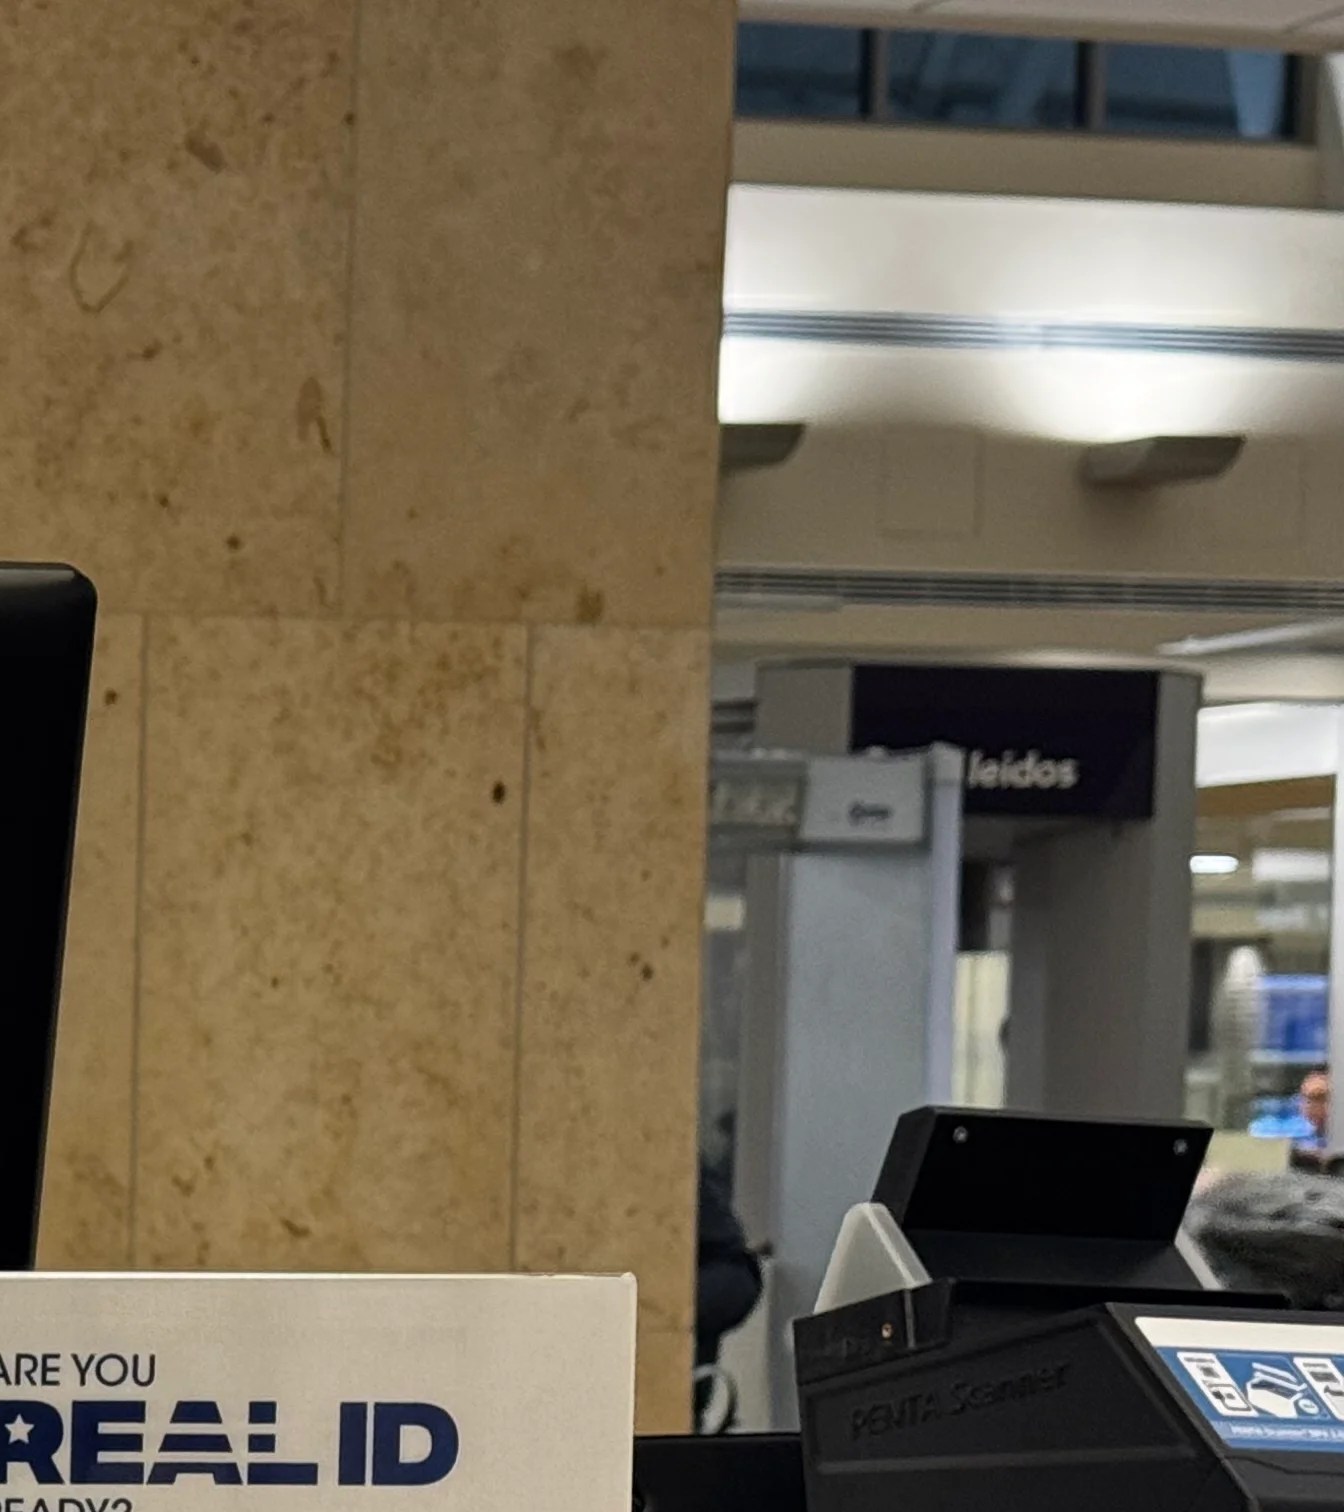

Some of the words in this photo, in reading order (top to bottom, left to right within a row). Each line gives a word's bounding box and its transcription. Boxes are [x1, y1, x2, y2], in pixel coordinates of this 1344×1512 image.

[968, 749, 1080, 791] leidos
[71, 1354, 155, 1387] YOU
[850, 1393, 939, 1440] PENTA
[948, 1360, 1072, 1417] Scanner
[338, 1402, 459, 1486] ID
